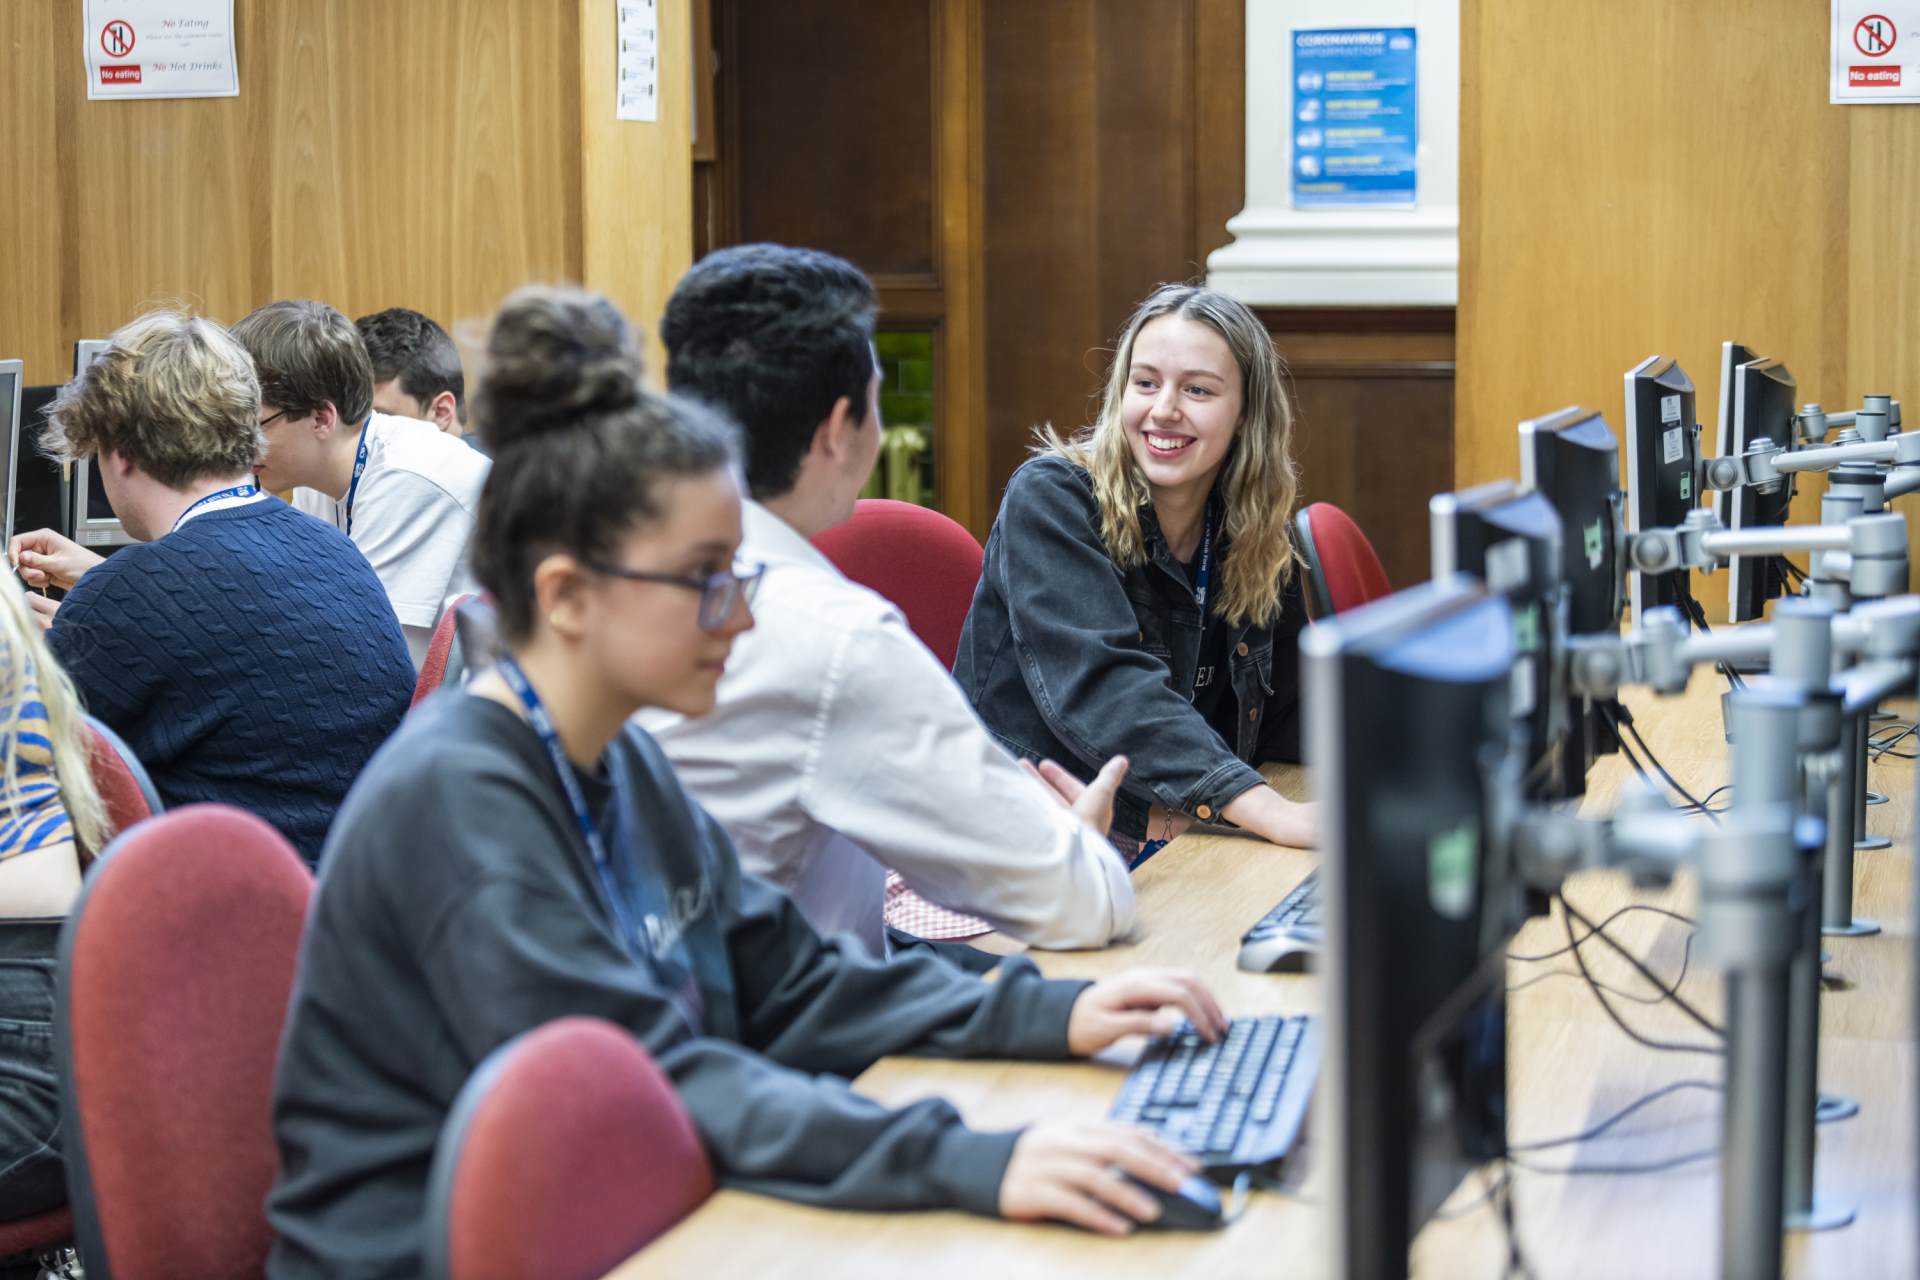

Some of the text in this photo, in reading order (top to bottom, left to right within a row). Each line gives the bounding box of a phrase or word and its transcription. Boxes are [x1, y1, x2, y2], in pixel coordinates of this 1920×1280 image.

[161, 19, 176, 28] No
[153, 62, 167, 71] No
[101, 69, 140, 81] No eating
[1850, 70, 1899, 82] No eating
